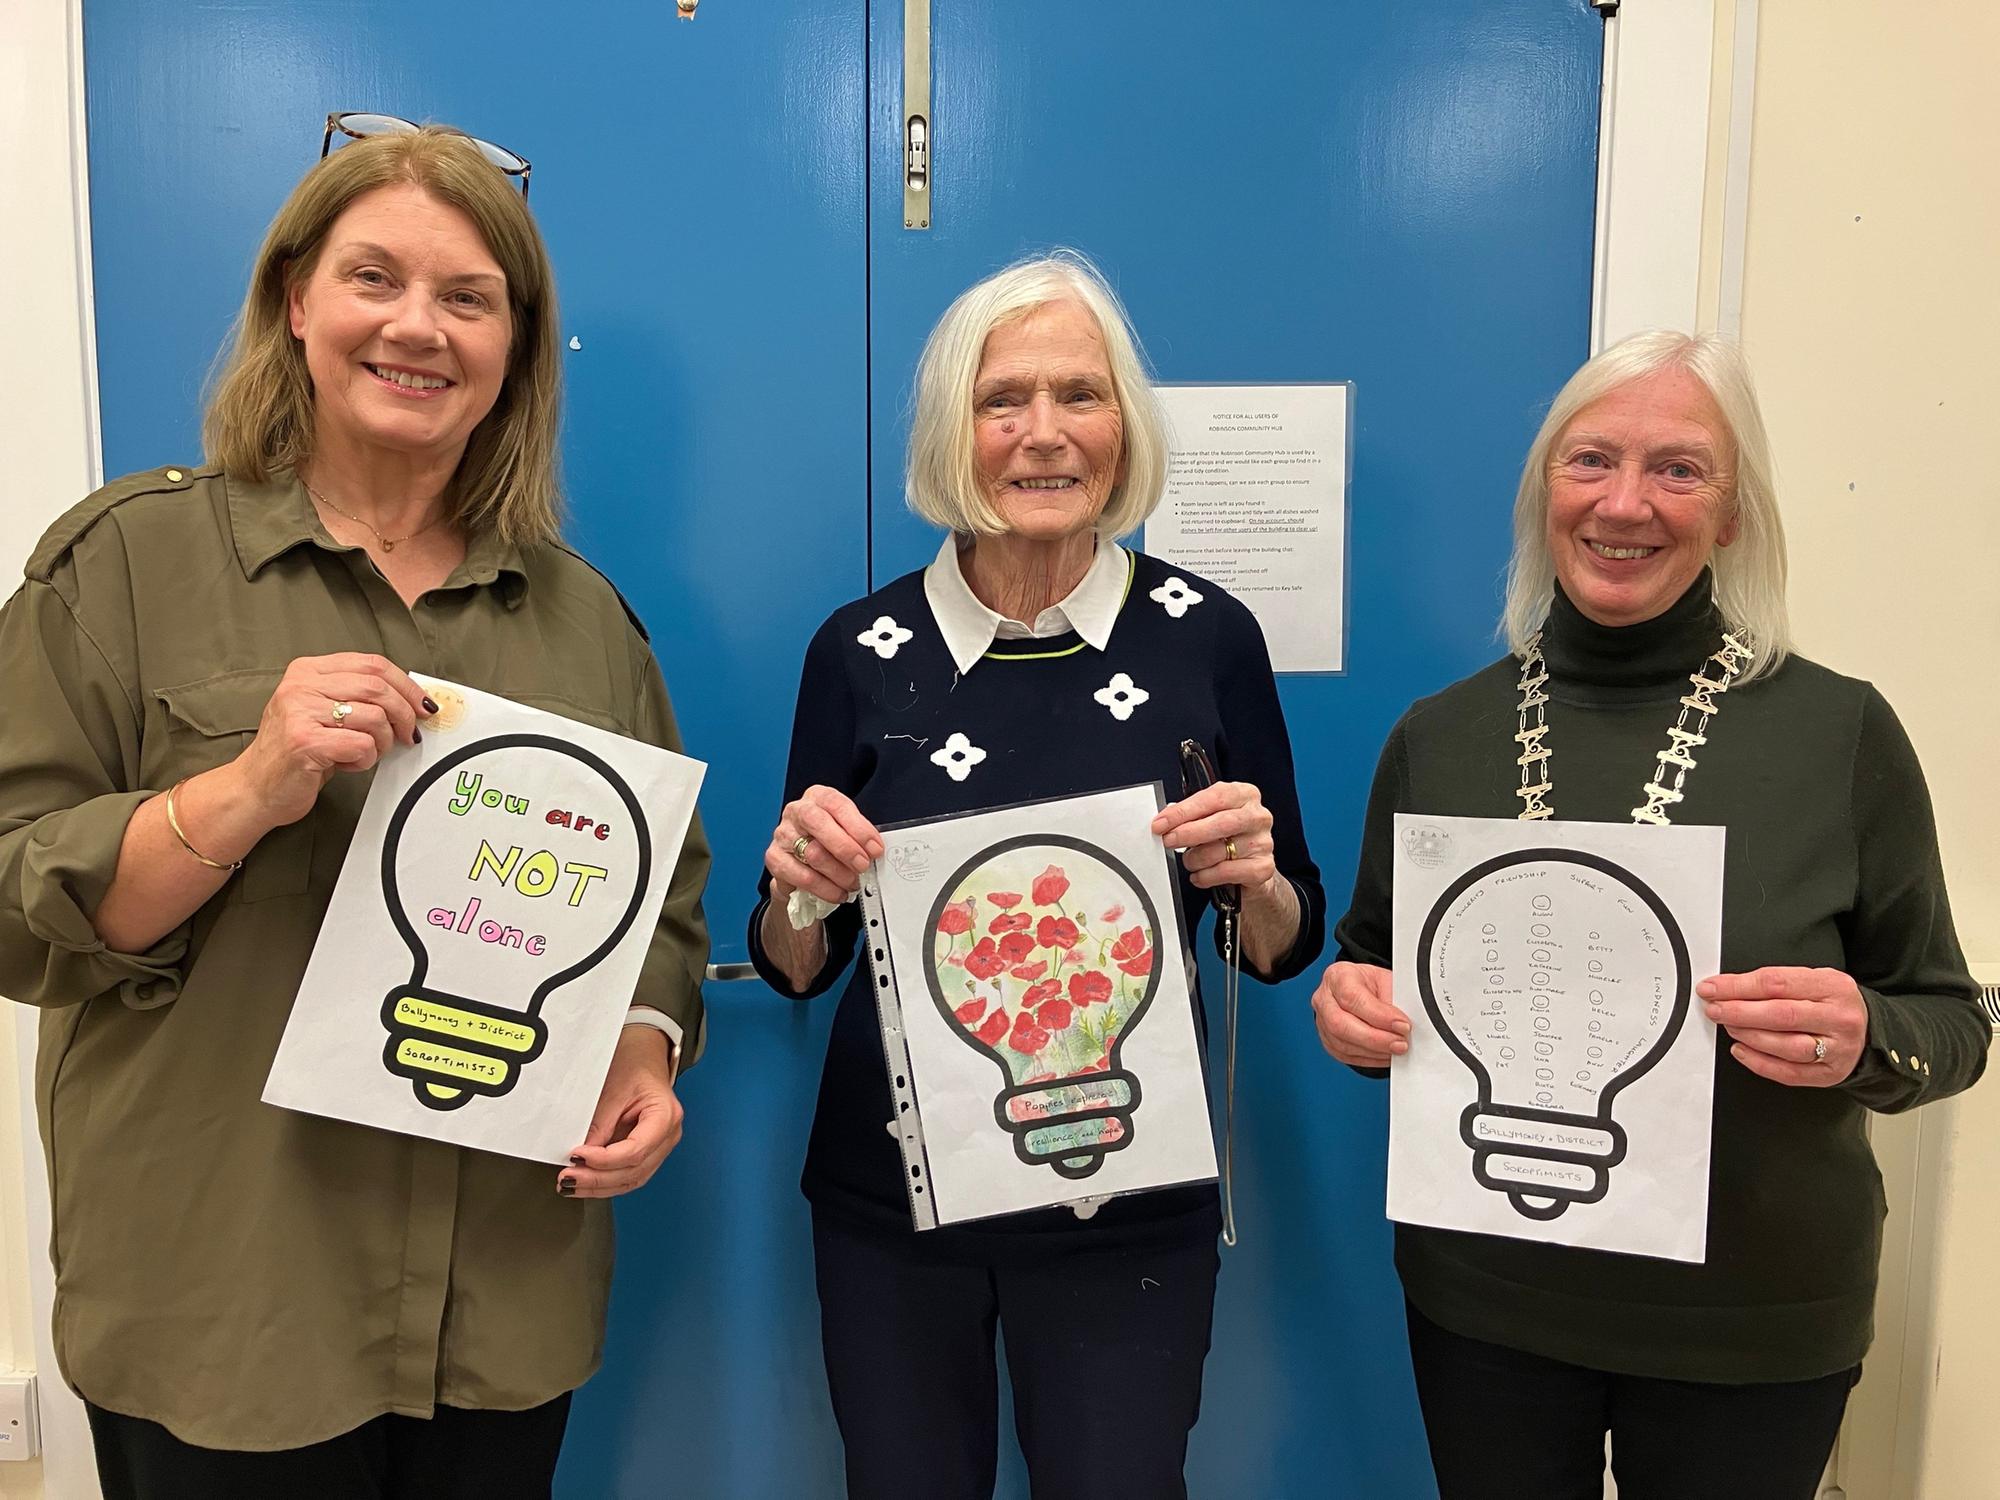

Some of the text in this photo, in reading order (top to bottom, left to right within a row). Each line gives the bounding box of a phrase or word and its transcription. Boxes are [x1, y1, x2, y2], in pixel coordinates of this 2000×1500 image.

[545, 809, 611, 842] are
[468, 839, 608, 907] NOT
[427, 897, 547, 956] alone
[1649, 976, 1662, 1027] KINDNESS
[401, 1003, 459, 1028] Ballymoney
[479, 1022, 526, 1040] District
[1612, 1037, 1647, 1074] LAUGHTER
[1480, 1122, 1545, 1143] BALLYMONEY
[1556, 1134, 1606, 1147] DISTRICT
[1503, 1162, 1582, 1182] SOROPTIMISTS
